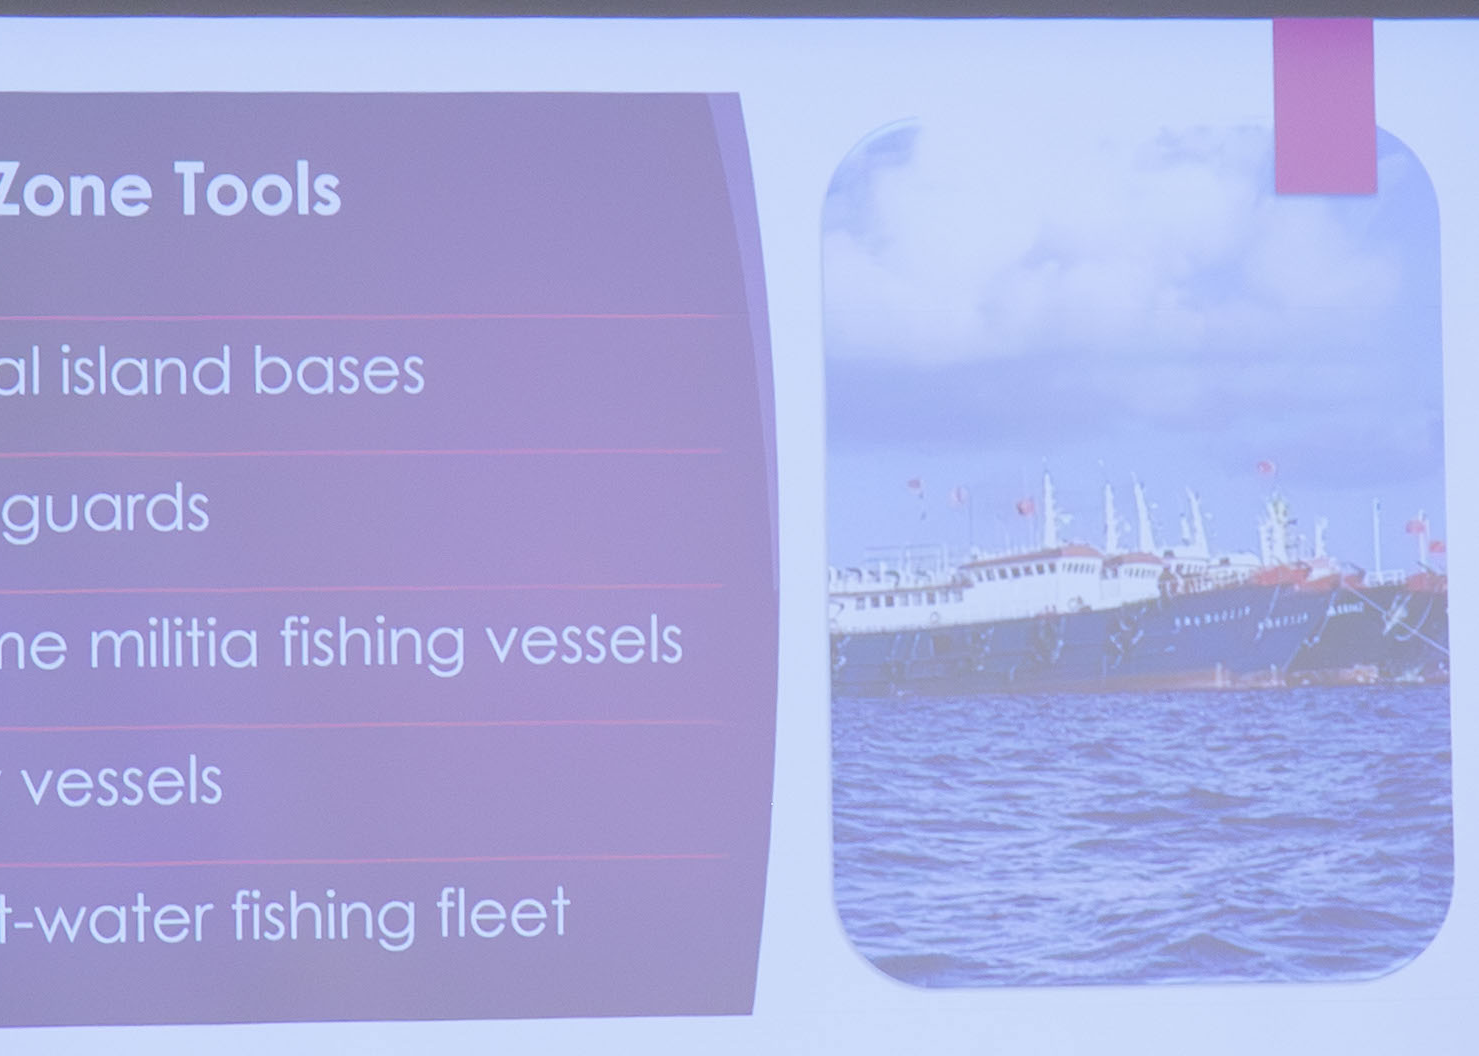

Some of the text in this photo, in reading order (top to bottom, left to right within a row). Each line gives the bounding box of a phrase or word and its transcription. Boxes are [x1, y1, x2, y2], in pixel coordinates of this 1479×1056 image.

[173, 159, 342, 217] Tools
[61, 344, 230, 396] island
[254, 344, 425, 395] bases
[1, 481, 210, 545] guards
[91, 616, 257, 668] militia
[280, 615, 464, 678] fishing
[485, 613, 683, 665] vessels
[20, 754, 223, 808] vessels
[231, 889, 415, 952] fishing
[436, 885, 571, 938] fleet
